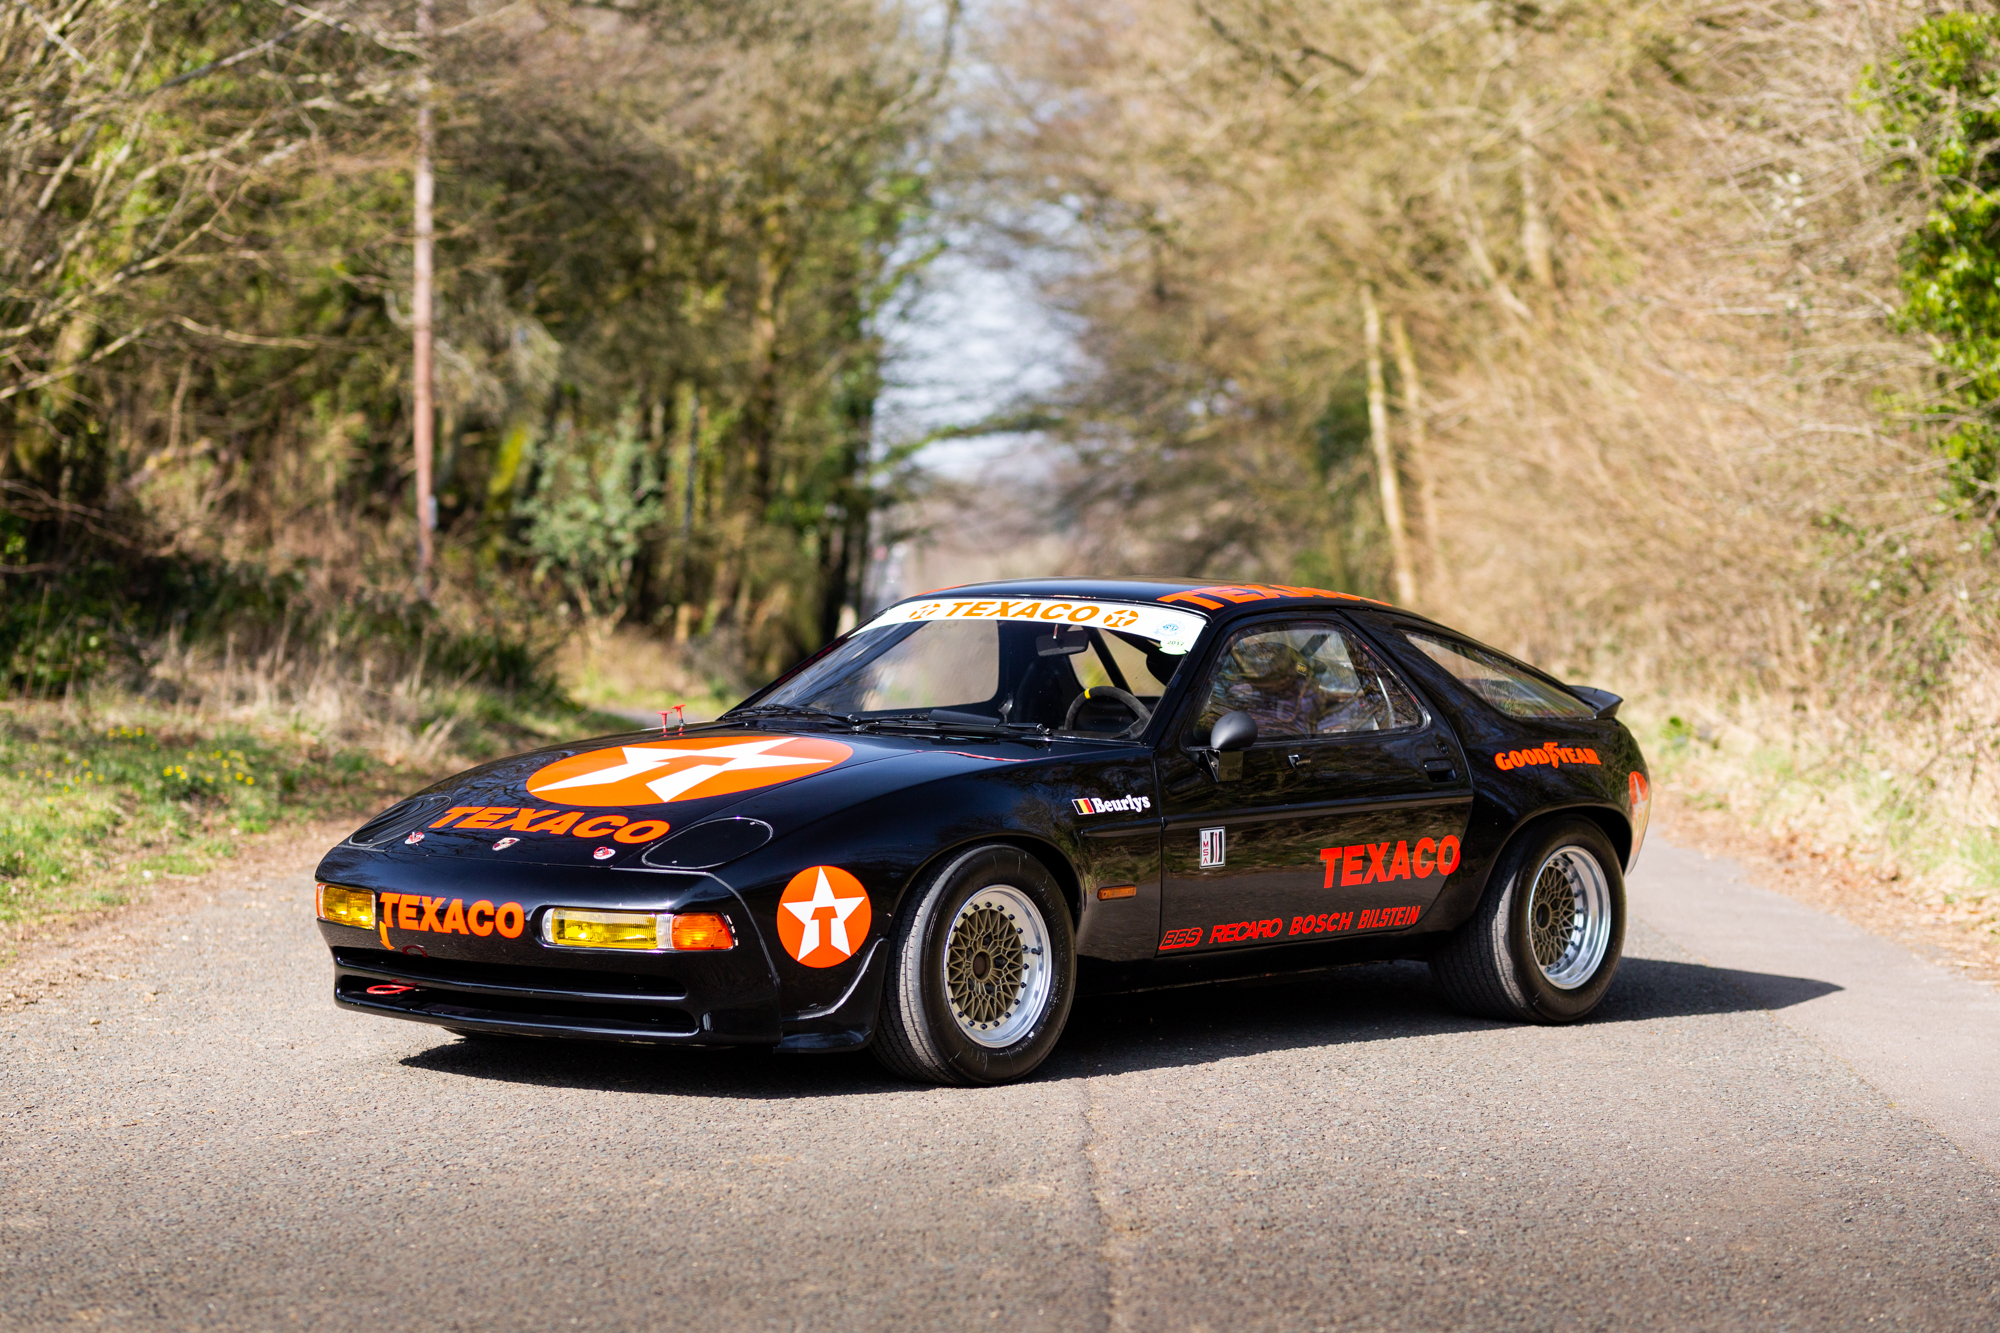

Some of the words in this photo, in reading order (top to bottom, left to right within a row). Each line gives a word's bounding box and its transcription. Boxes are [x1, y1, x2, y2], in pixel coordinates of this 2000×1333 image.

[945, 601, 1100, 622] TEXACO
[1494, 742, 1602, 771] GOODYEAR
[1090, 794, 1151, 813] Beurlys
[429, 806, 671, 844] TEXACO
[1202, 832, 1210, 864] IMSA
[1320, 835, 1461, 888] TEXACO
[380, 891, 525, 939] TEXACO
[1159, 927, 1203, 950] BBS
[1209, 918, 1283, 944] RECARO
[1289, 912, 1354, 936] BOSCH
[1357, 906, 1421, 930] BILSTEIN
